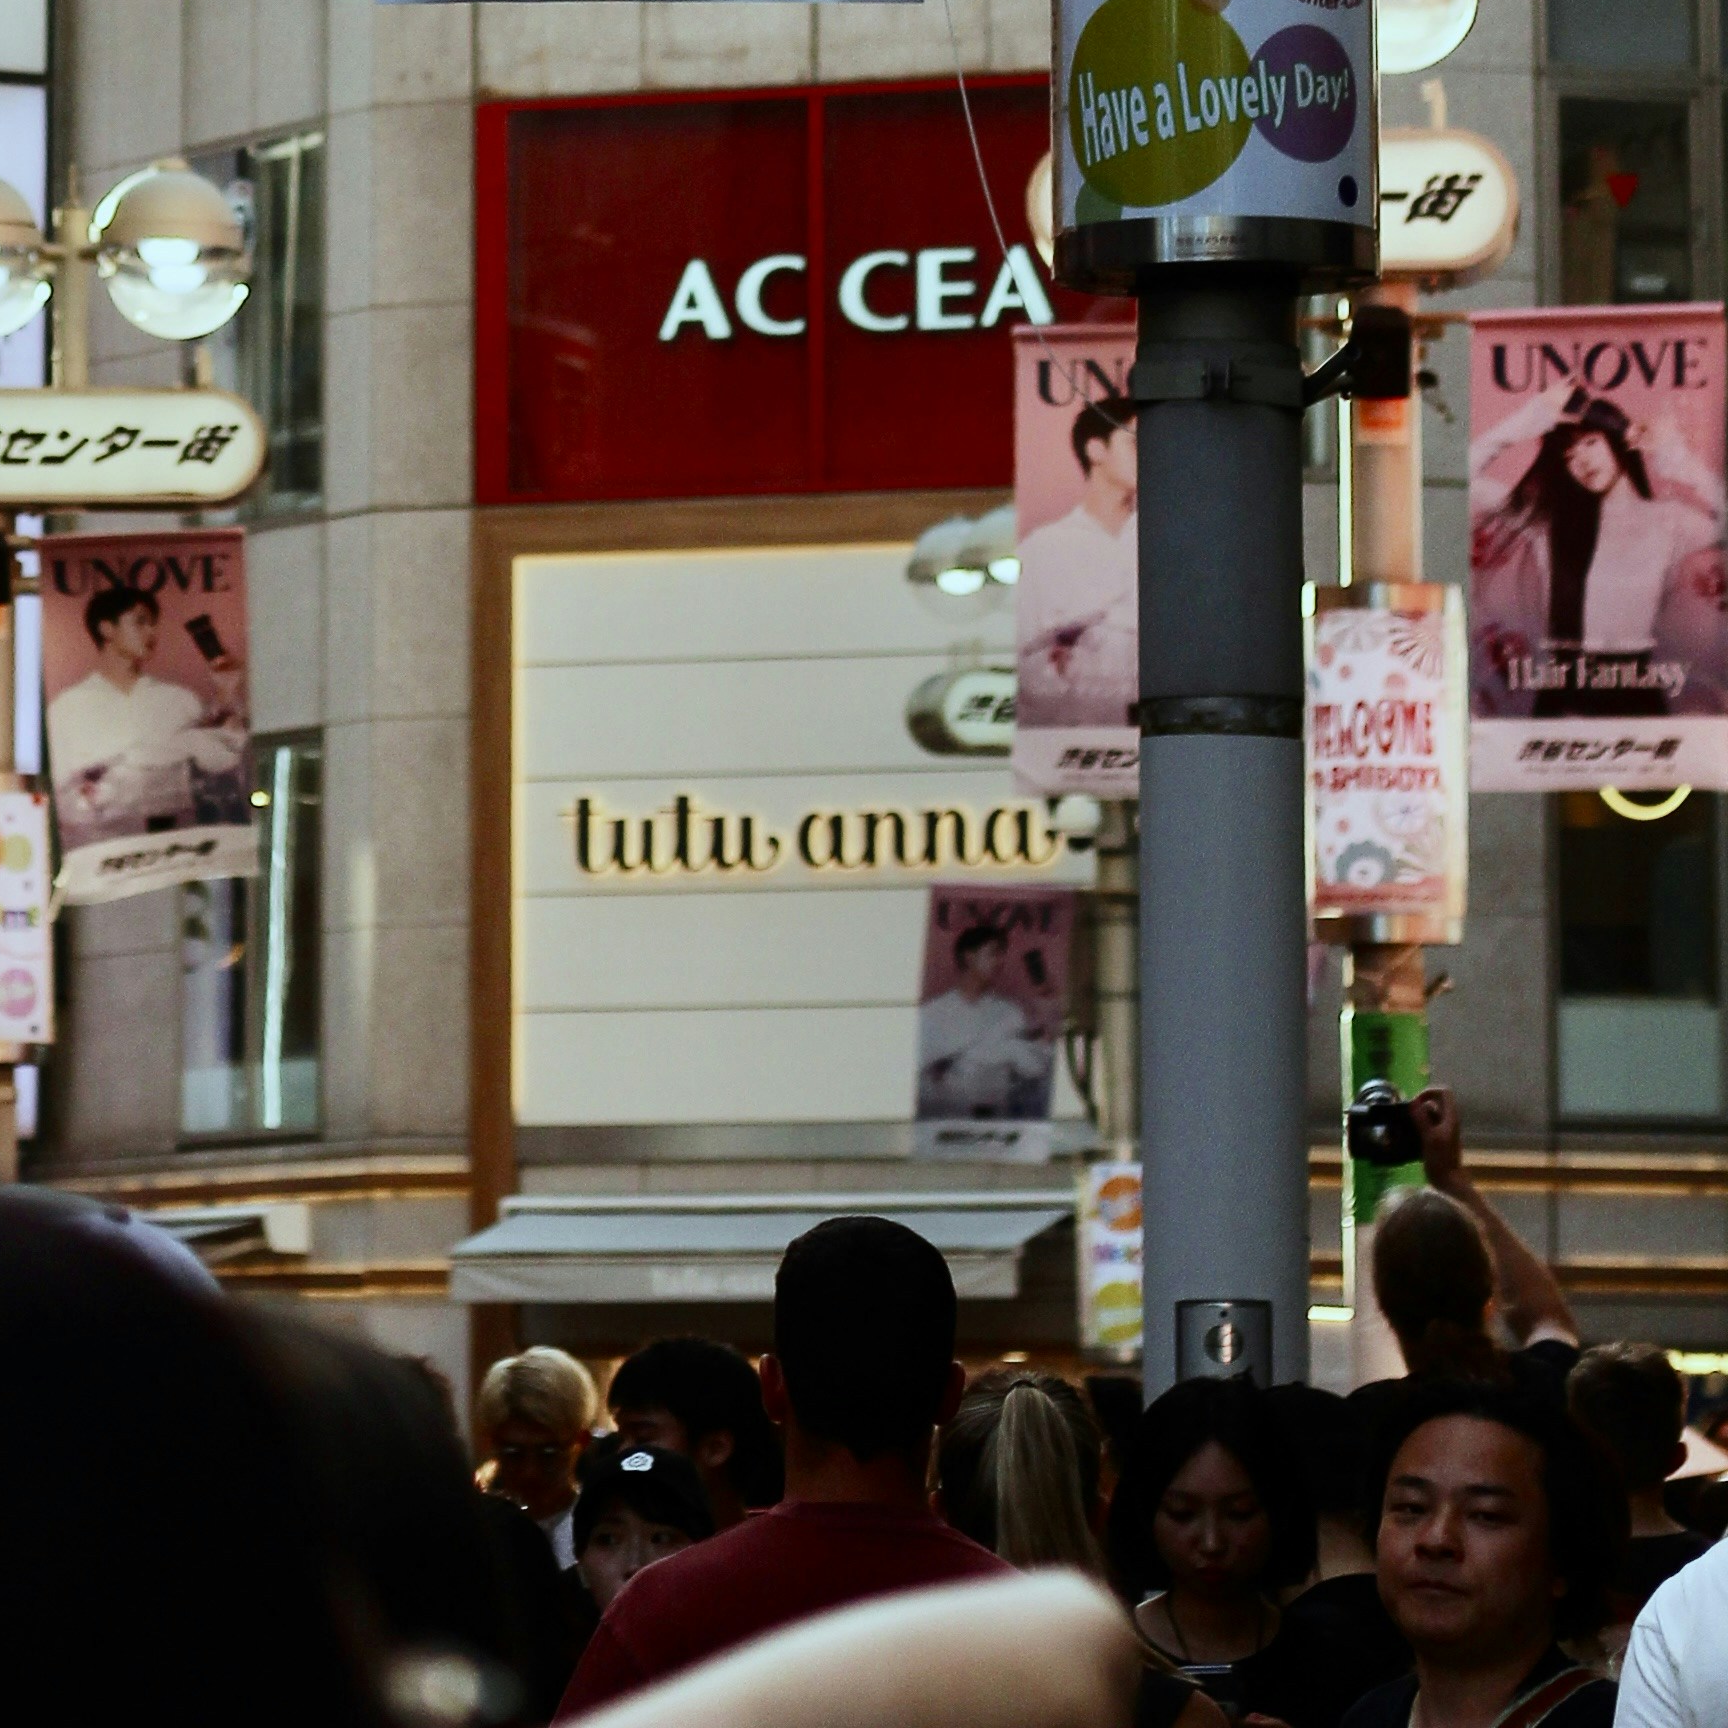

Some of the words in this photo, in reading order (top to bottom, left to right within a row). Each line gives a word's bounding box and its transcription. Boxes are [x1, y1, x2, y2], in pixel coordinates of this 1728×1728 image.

[1077, 71, 1151, 168] Have
[1152, 80, 1177, 142] a
[1177, 58, 1288, 131] Lovely
[1293, 62, 1350, 113] Day!
[1491, 337, 1709, 393] UNOVE
[51, 553, 233, 596] UNOVE
[1507, 656, 1571, 691] Hair
[1575, 655, 1687, 698] Fantasy
